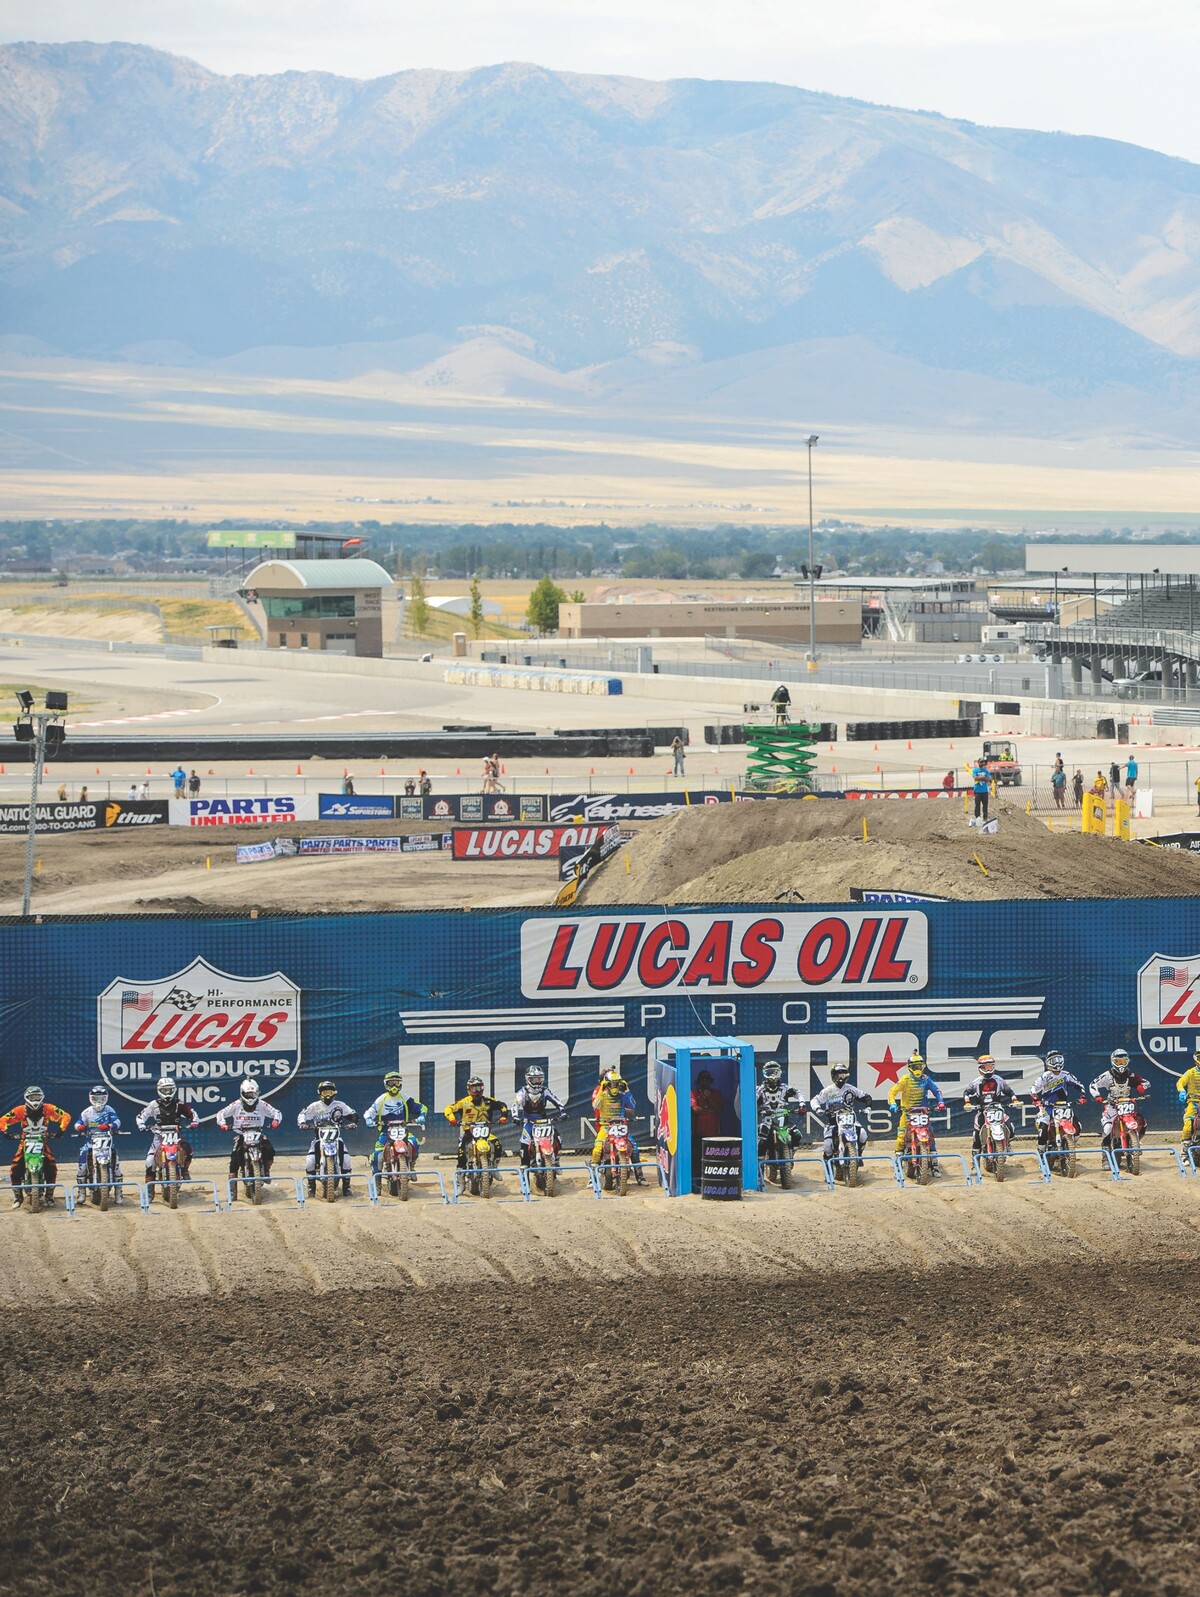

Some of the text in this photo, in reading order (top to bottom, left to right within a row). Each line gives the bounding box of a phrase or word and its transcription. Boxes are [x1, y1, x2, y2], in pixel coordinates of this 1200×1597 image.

[190, 797, 296, 816] PARTS
[588, 802, 686, 820] alpinesta
[54, 805, 96, 820] GUARD
[117, 812, 162, 824] thor
[190, 814, 296, 826] UNLIMITED
[302, 840, 332, 848] PARTS
[333, 840, 364, 848] PARTS
[366, 839, 398, 847] PARTS
[466, 830, 554, 856] LUCAS
[538, 916, 912, 990] LUCAS OIL
[207, 989, 223, 997] HI-
[207, 998, 292, 1008] PERFORMANCE
[122, 1012, 288, 1050] LUCAS
[1150, 1036, 1188, 1052] OIL
[110, 1058, 290, 1079] OIL PRODUCTS
[399, 1029, 1046, 1113] MOTROSS
[178, 1086, 226, 1103] INC.
[840, 1114, 854, 1124] 38
[986, 1111, 1002, 1122] 50
[1056, 1108, 1071, 1119] 34
[910, 1114, 928, 1126] 36
[322, 1130, 337, 1140] 77
[389, 1128, 406, 1139] 93
[472, 1127, 489, 1138] 80
[534, 1126, 551, 1137] 677
[609, 1125, 628, 1136] 43
[162, 1133, 179, 1145] 244
[25, 1142, 44, 1153] 72
[705, 1146, 740, 1156] LUCAS OIL
[704, 1166, 739, 1175] LUCAS OIL
[704, 1186, 738, 1195] LUCAS OIL
